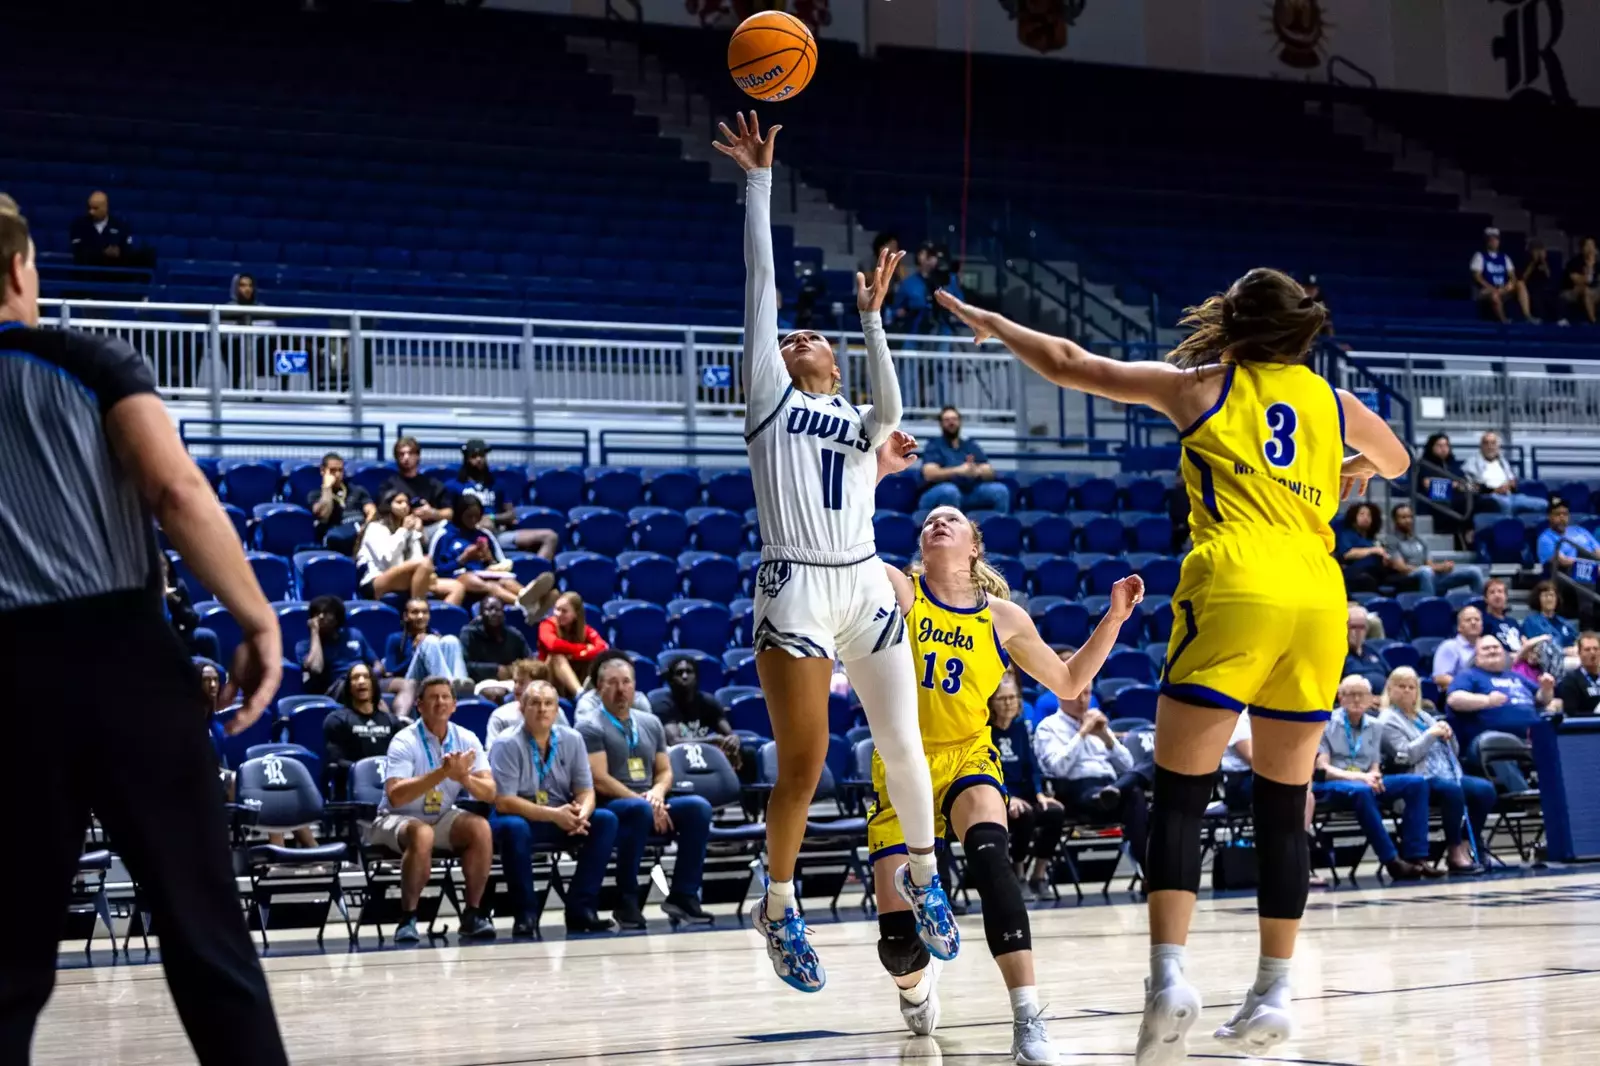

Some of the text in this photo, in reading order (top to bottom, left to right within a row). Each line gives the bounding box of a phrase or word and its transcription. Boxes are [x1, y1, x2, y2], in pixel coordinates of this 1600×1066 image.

[735, 65, 784, 89] Wilson
[786, 406, 872, 453] OWLS
[1264, 402, 1298, 468] 3
[821, 448, 846, 510] 11
[918, 617, 974, 651] Jacks
[920, 651, 964, 695] 13
[261, 759, 288, 785] R
[683, 743, 708, 769] R
